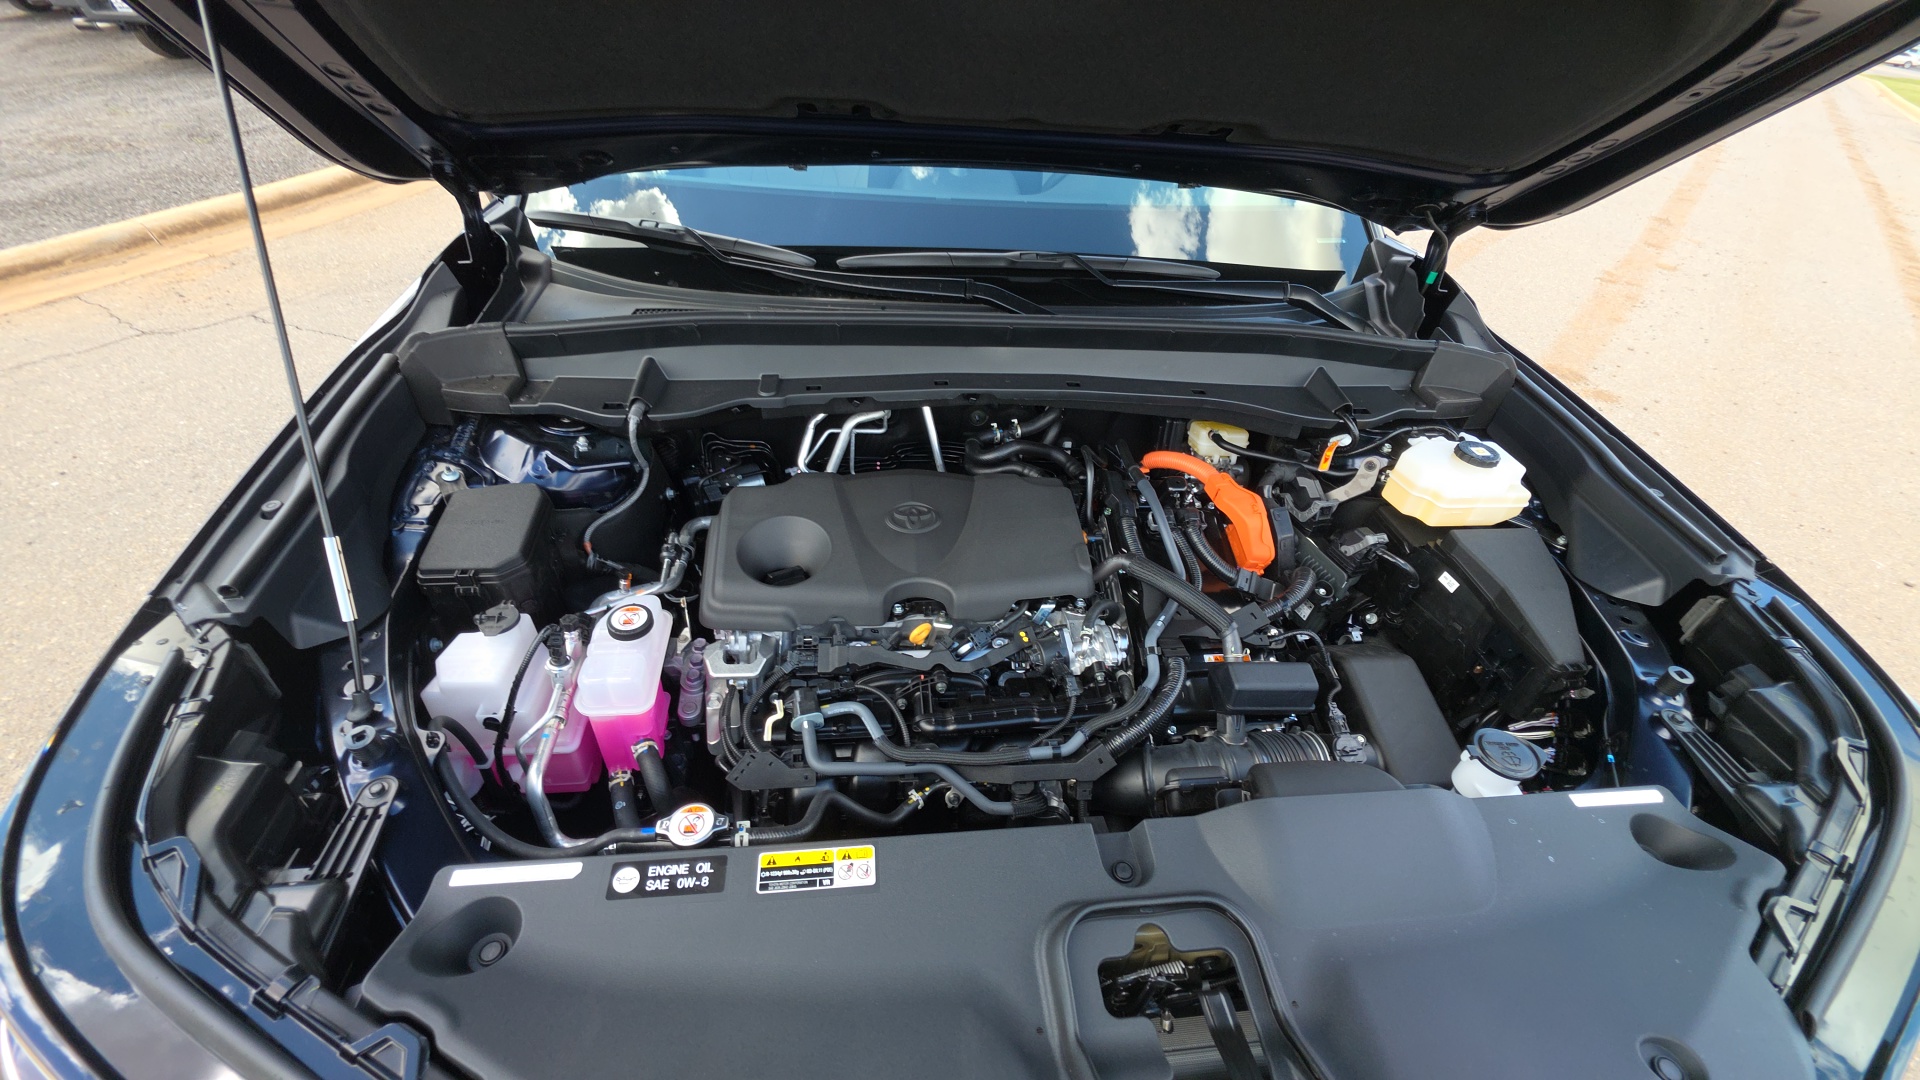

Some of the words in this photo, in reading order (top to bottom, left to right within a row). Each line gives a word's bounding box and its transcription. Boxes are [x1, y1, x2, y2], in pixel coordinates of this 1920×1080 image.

[648, 864, 690, 877] ENGINE
[695, 862, 714, 874] OIL
[645, 879, 670, 891] SAE
[676, 876, 709, 889] 0W-8
